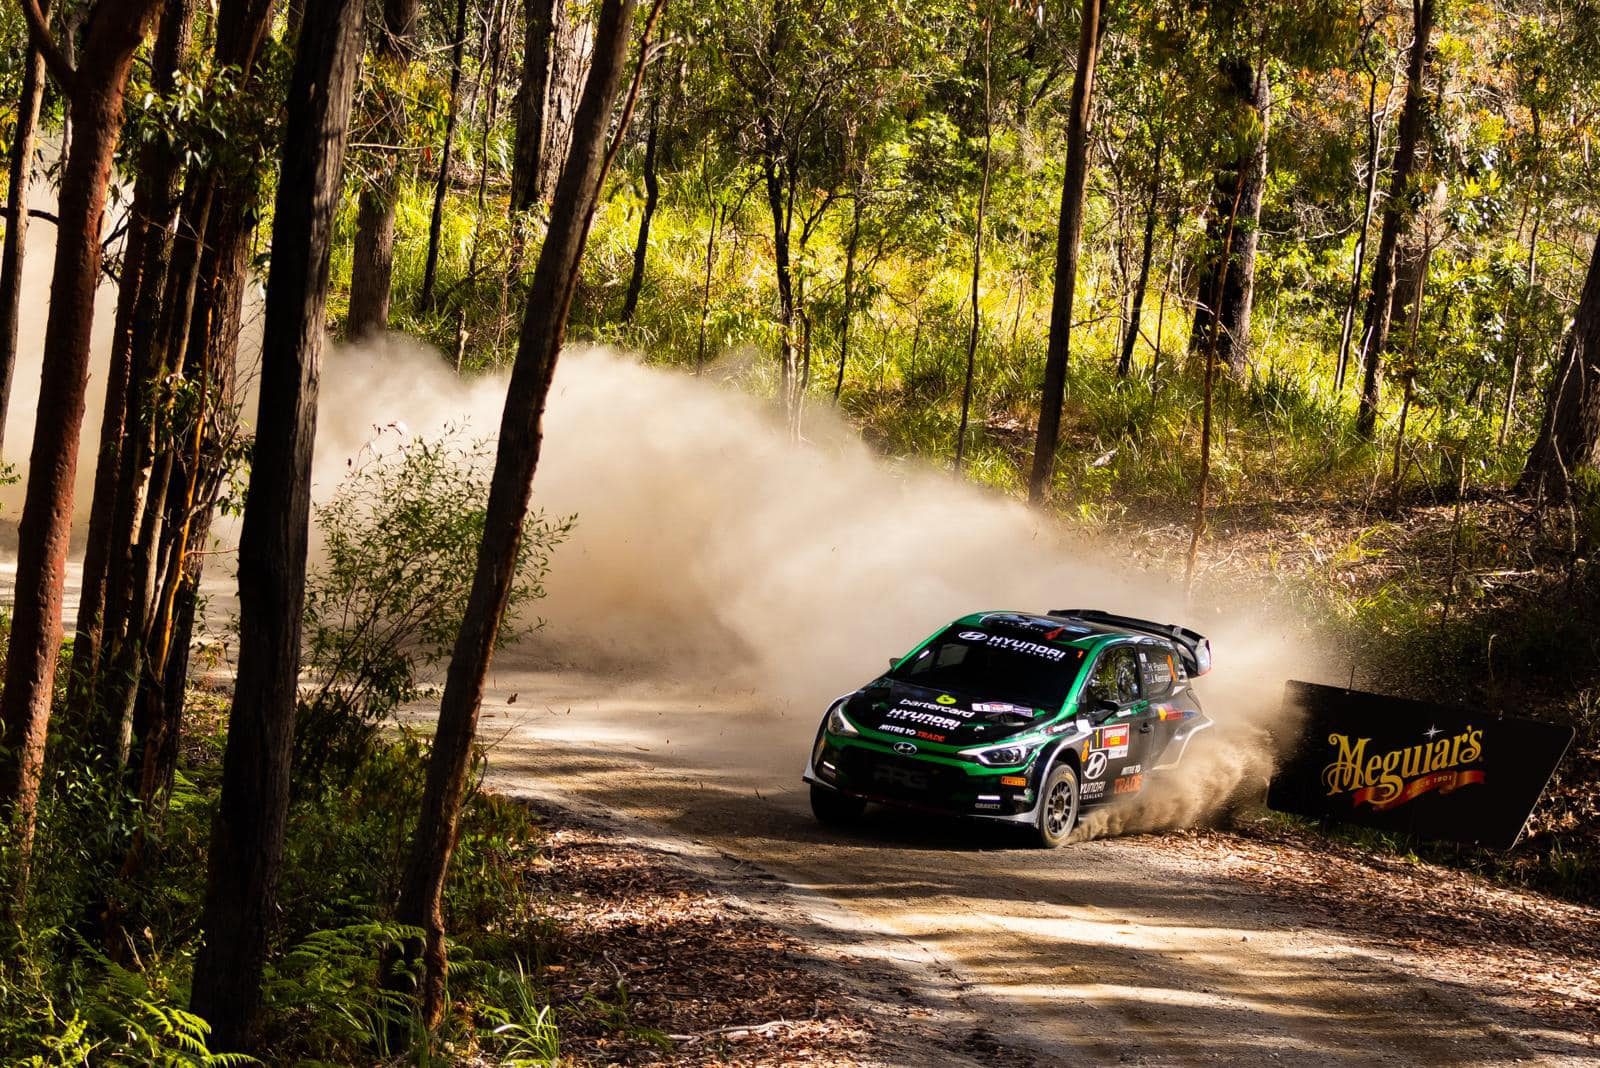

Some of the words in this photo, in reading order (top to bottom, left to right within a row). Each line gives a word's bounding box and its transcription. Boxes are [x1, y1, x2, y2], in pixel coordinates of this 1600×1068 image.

[990, 636, 1066, 660] HYUNDAI
[889, 708, 961, 728] HYUNDAI
[900, 698, 976, 718] bartercard
[916, 730, 946, 742] TRADE
[1094, 728, 1100, 748] 1
[1080, 782, 1106, 794] YUNDAI
